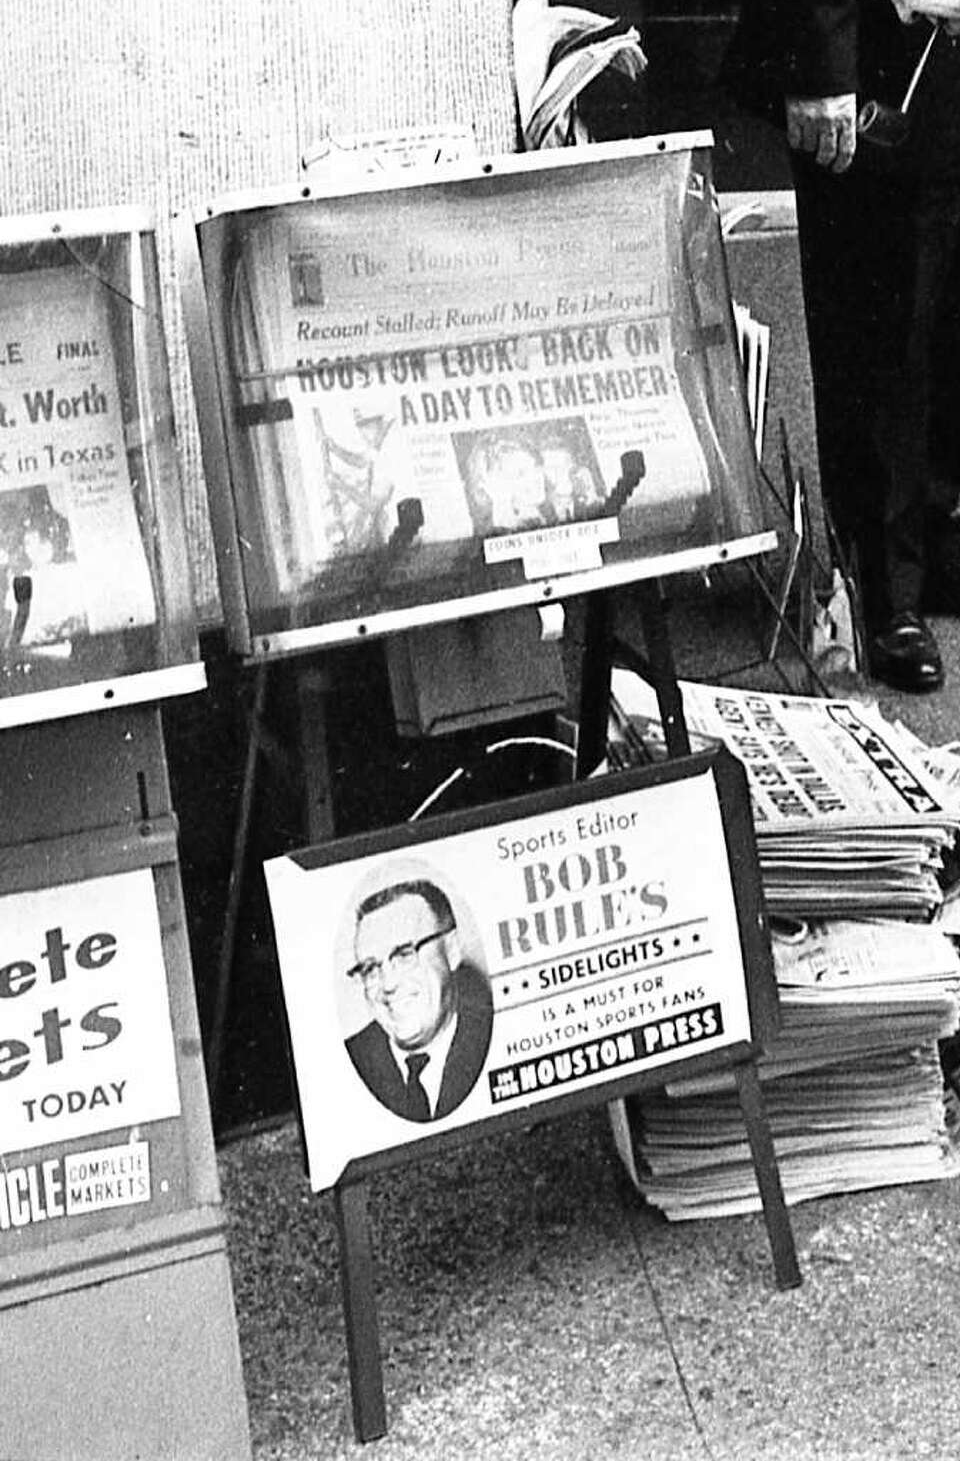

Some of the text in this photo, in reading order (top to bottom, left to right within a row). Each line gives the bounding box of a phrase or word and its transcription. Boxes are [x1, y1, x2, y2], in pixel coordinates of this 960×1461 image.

[297, 319, 369, 341] Recount
[446, 301, 508, 329] Runoff
[513, 300, 549, 321] May
[57, 340, 100, 360] FINAL
[297, 350, 429, 392] HOUSTON
[541, 325, 613, 367] BACK
[624, 321, 660, 357] ON
[23, 383, 108, 424] Worth
[401, 365, 669, 427] A DAY TO REMEMBER
[18, 450, 38, 474] in
[43, 442, 116, 469] Texas
[829, 705, 940, 813] EXTRA
[497, 811, 639, 861] Sports Editor
[523, 844, 628, 904] BOB
[498, 881, 669, 960] RULE'S
[0, 926, 118, 998] ete
[538, 937, 664, 990] SIDELIGHTS
[506, 986, 706, 1057] HOUSTON SPORTS FANS
[542, 976, 665, 1022] IS A MUST FOR
[0, 1001, 123, 1082] ets
[519, 1008, 718, 1092] HOUSTON PRESS
[22, 1080, 128, 1123] TODAY
[69, 1153, 145, 1183] COMPLETE
[70, 1175, 148, 1207] MARKETS
